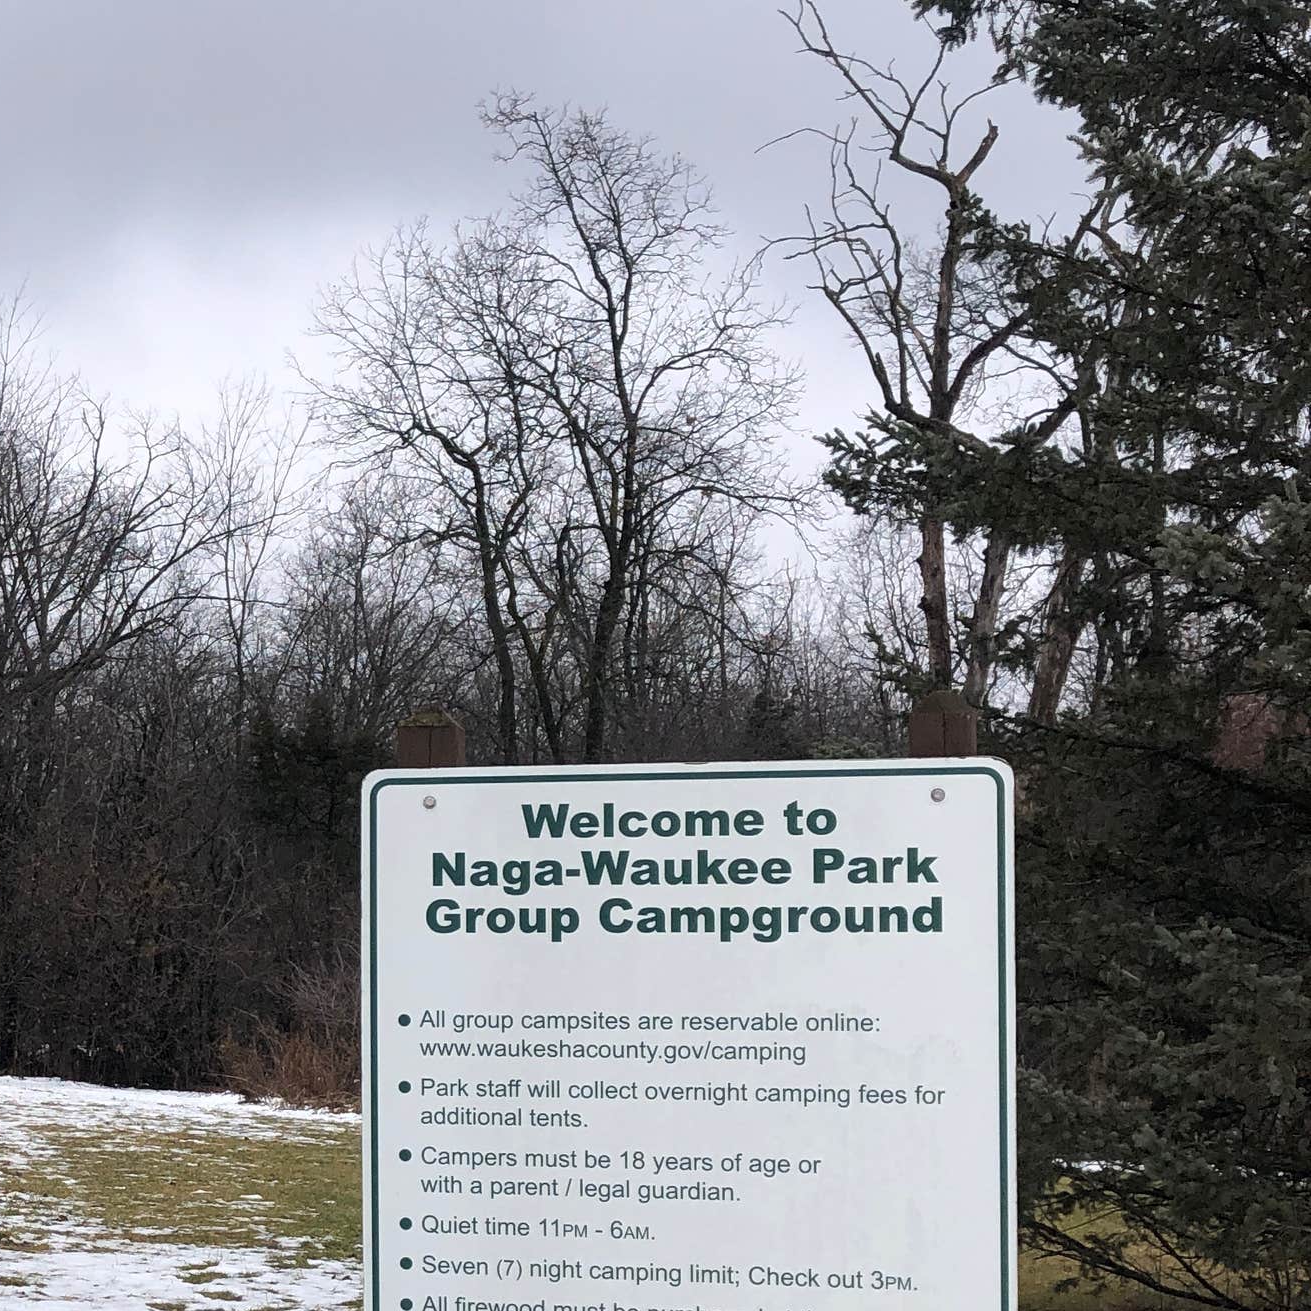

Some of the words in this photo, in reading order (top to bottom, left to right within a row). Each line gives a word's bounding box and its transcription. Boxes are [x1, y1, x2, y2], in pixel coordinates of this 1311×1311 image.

[520, 802, 765, 839] Welcome
[783, 800, 837, 836] to
[432, 849, 792, 896] Naga-Waukee
[812, 847, 939, 885] Park
[425, 898, 580, 943] Group
[598, 896, 943, 943] Campground
[419, 1009, 445, 1028] All
[452, 1014, 514, 1034] group
[521, 1010, 631, 1034] campsites
[637, 1015, 673, 1030] are
[681, 1012, 798, 1032] reservable
[805, 1012, 880, 1032] online:
[419, 1039, 806, 1066] www.waukeshacounty.gov/camping
[421, 1077, 469, 1097] Park
[476, 1078, 522, 1098] staff
[527, 1079, 561, 1099] will
[568, 1080, 638, 1100] collect
[644, 1082, 748, 1106] overnight
[755, 1083, 850, 1108] camping
[858, 1084, 907, 1105] fees
[914, 1085, 946, 1105] for
[420, 1106, 522, 1127] additional
[529, 1108, 588, 1128] tents.
[421, 1146, 518, 1171] Campers
[525, 1150, 578, 1169] must
[584, 1149, 611, 1169] be
[620, 1150, 645, 1170] 18
[652, 1156, 714, 1175] years
[720, 1152, 743, 1172] of
[748, 1158, 791, 1178] age
[798, 1159, 822, 1174] or
[420, 1175, 463, 1194] with
[470, 1180, 483, 1195] a
[490, 1178, 559, 1200] parent
[579, 1178, 630, 1203] legal
[637, 1181, 741, 1204] guardian.
[421, 1214, 479, 1235] Quiet
[484, 1216, 530, 1237] time
[539, 1218, 588, 1238] 11PM
[610, 1220, 655, 1241] 6AM.
[422, 1254, 489, 1276] Seven
[496, 1259, 523, 1281] (7)
[530, 1259, 583, 1283] night
[589, 1262, 682, 1288] camping
[690, 1264, 740, 1288] limit;
[748, 1266, 820, 1288] Check
[827, 1271, 863, 1289] out
[871, 1270, 918, 1291] 3PM.
